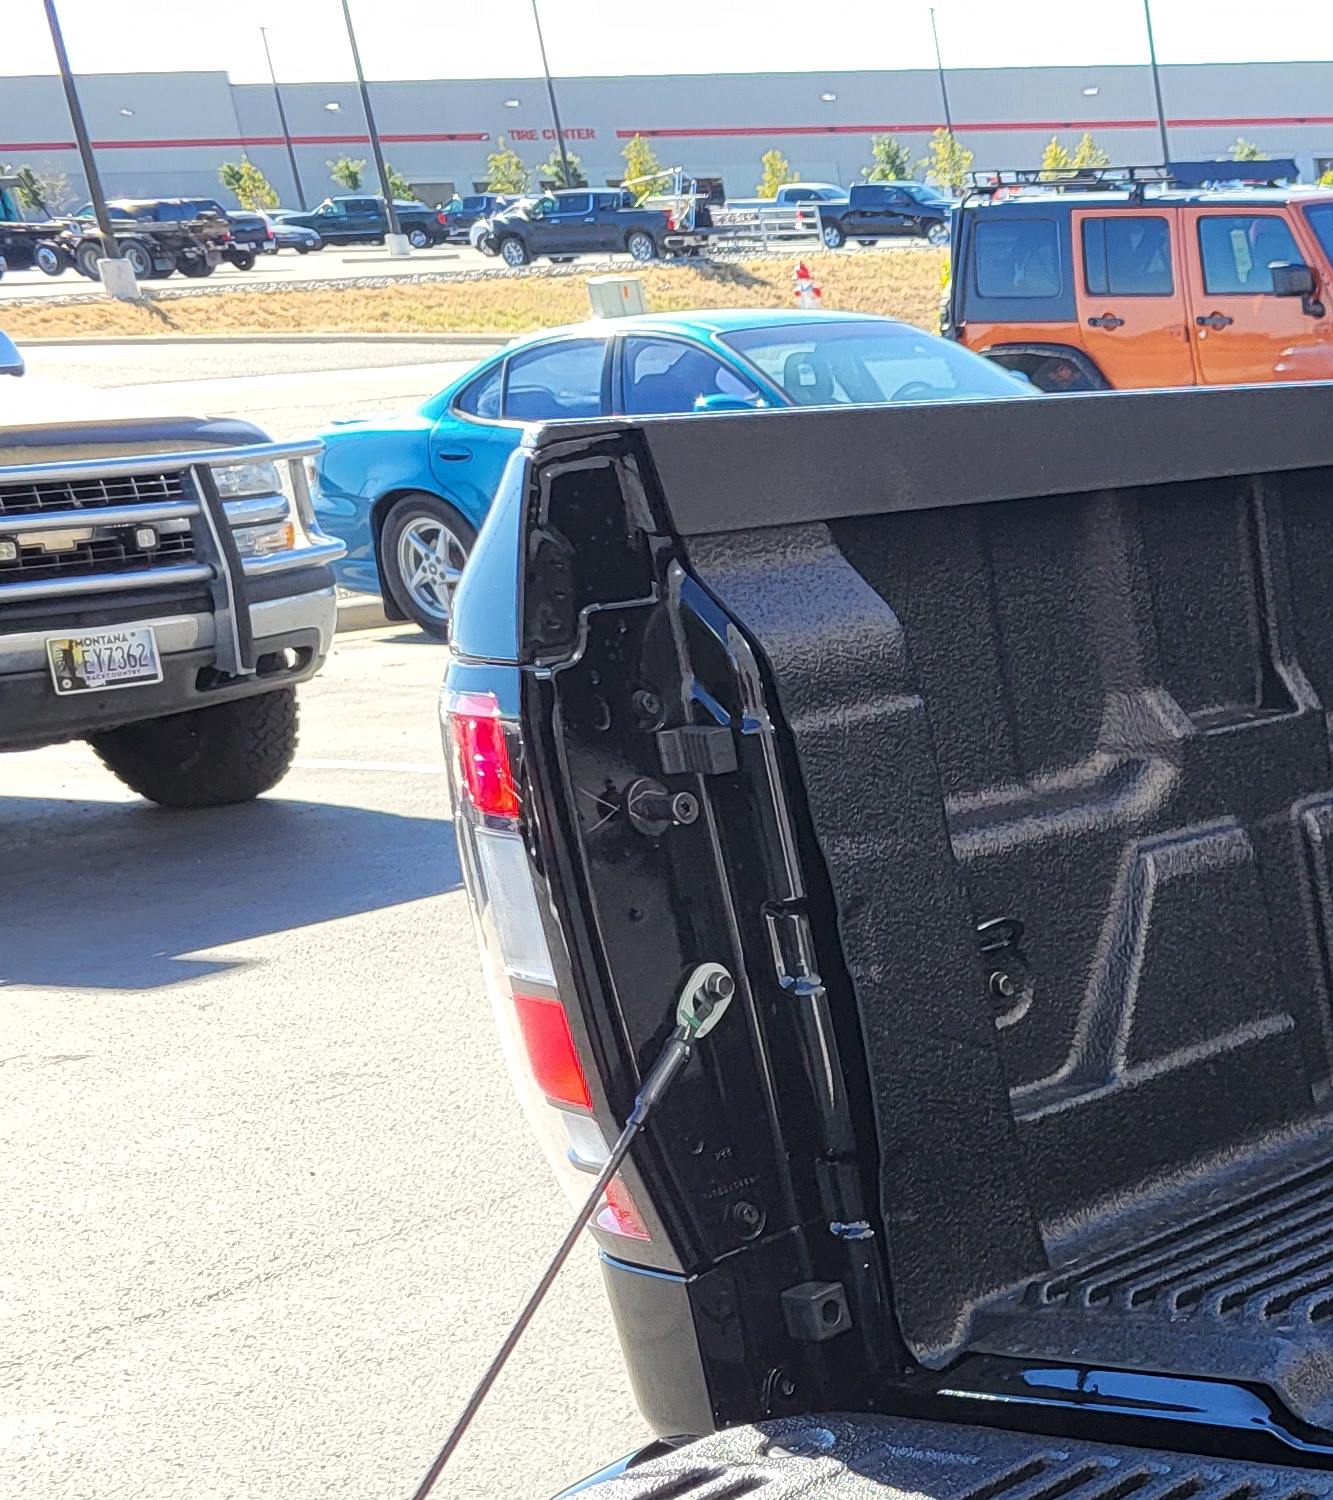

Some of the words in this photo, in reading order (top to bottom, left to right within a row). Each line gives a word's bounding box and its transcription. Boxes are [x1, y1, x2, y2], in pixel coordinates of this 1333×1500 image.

[507, 129, 539, 141] TIRE
[73, 633, 129, 648] MONTANA
[81, 642, 150, 675] EYZ362
